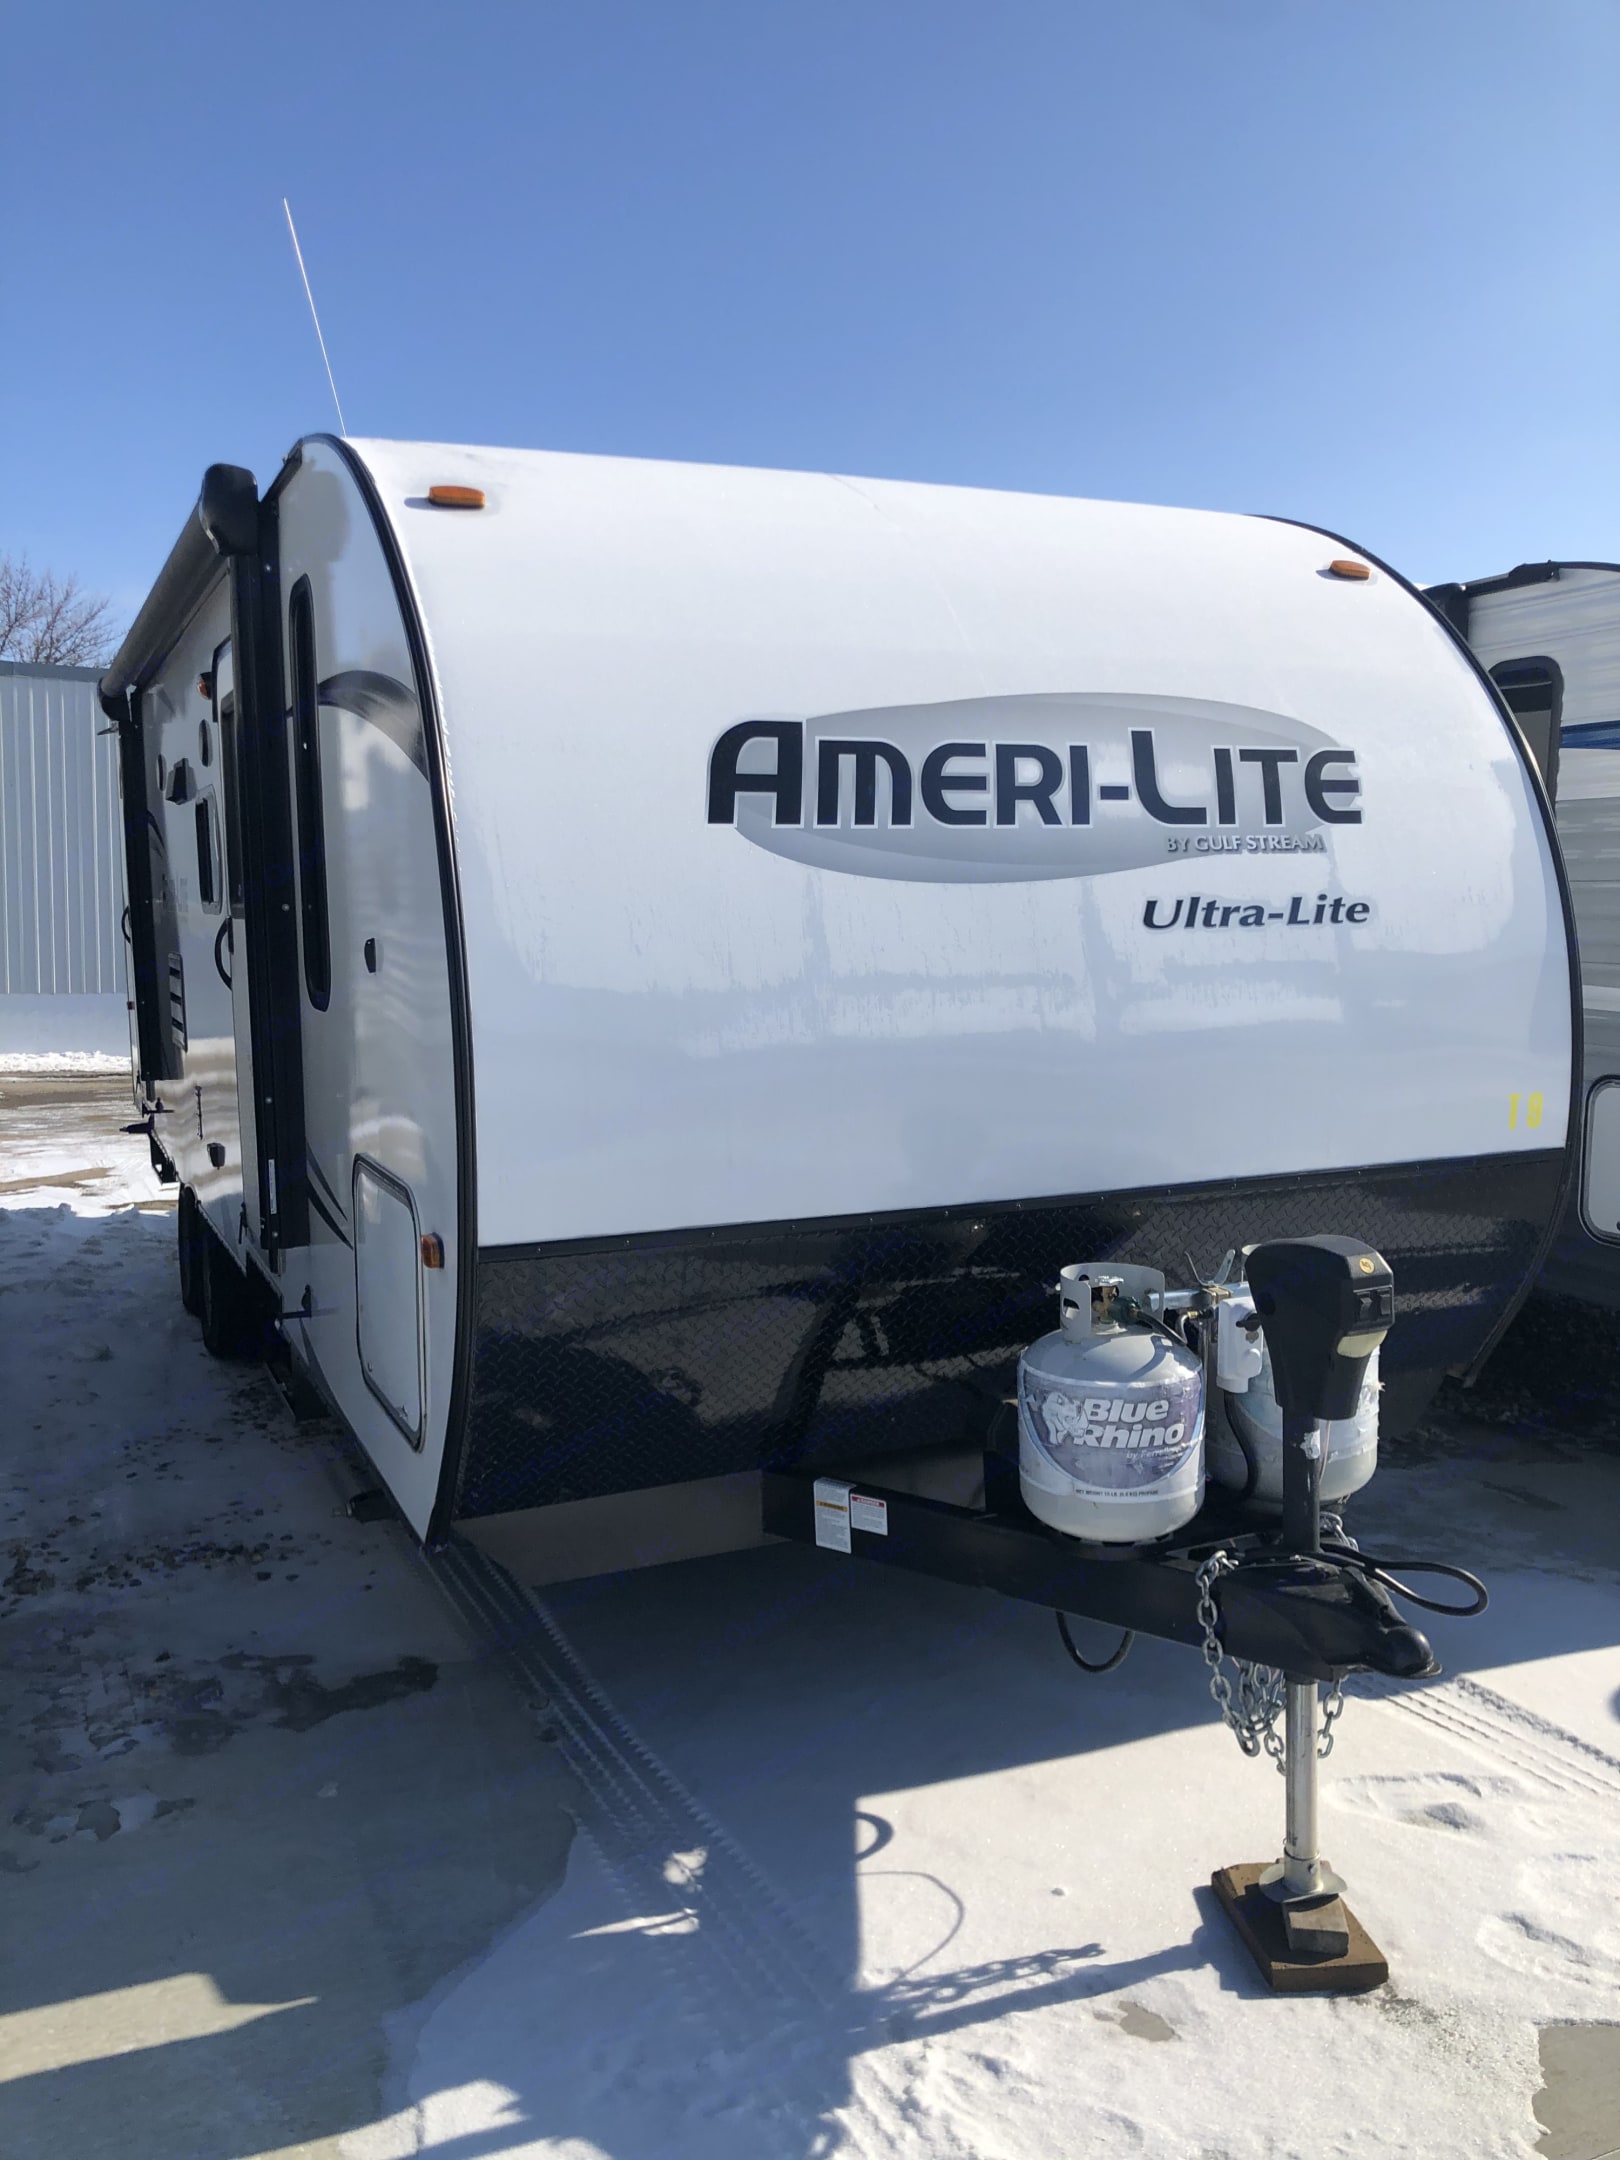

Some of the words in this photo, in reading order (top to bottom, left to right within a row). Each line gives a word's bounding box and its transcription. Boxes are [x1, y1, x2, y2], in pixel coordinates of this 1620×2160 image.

[708, 719, 1363, 826] AMERI-LITE
[1167, 834, 1190, 852] BY
[1194, 834, 1243, 853] GULF
[1245, 832, 1327, 854] STREAM
[1142, 893, 1371, 930] Ultra-Lite
[1083, 1398, 1170, 1423] Blue
[1073, 1423, 1185, 1449] Rhino
